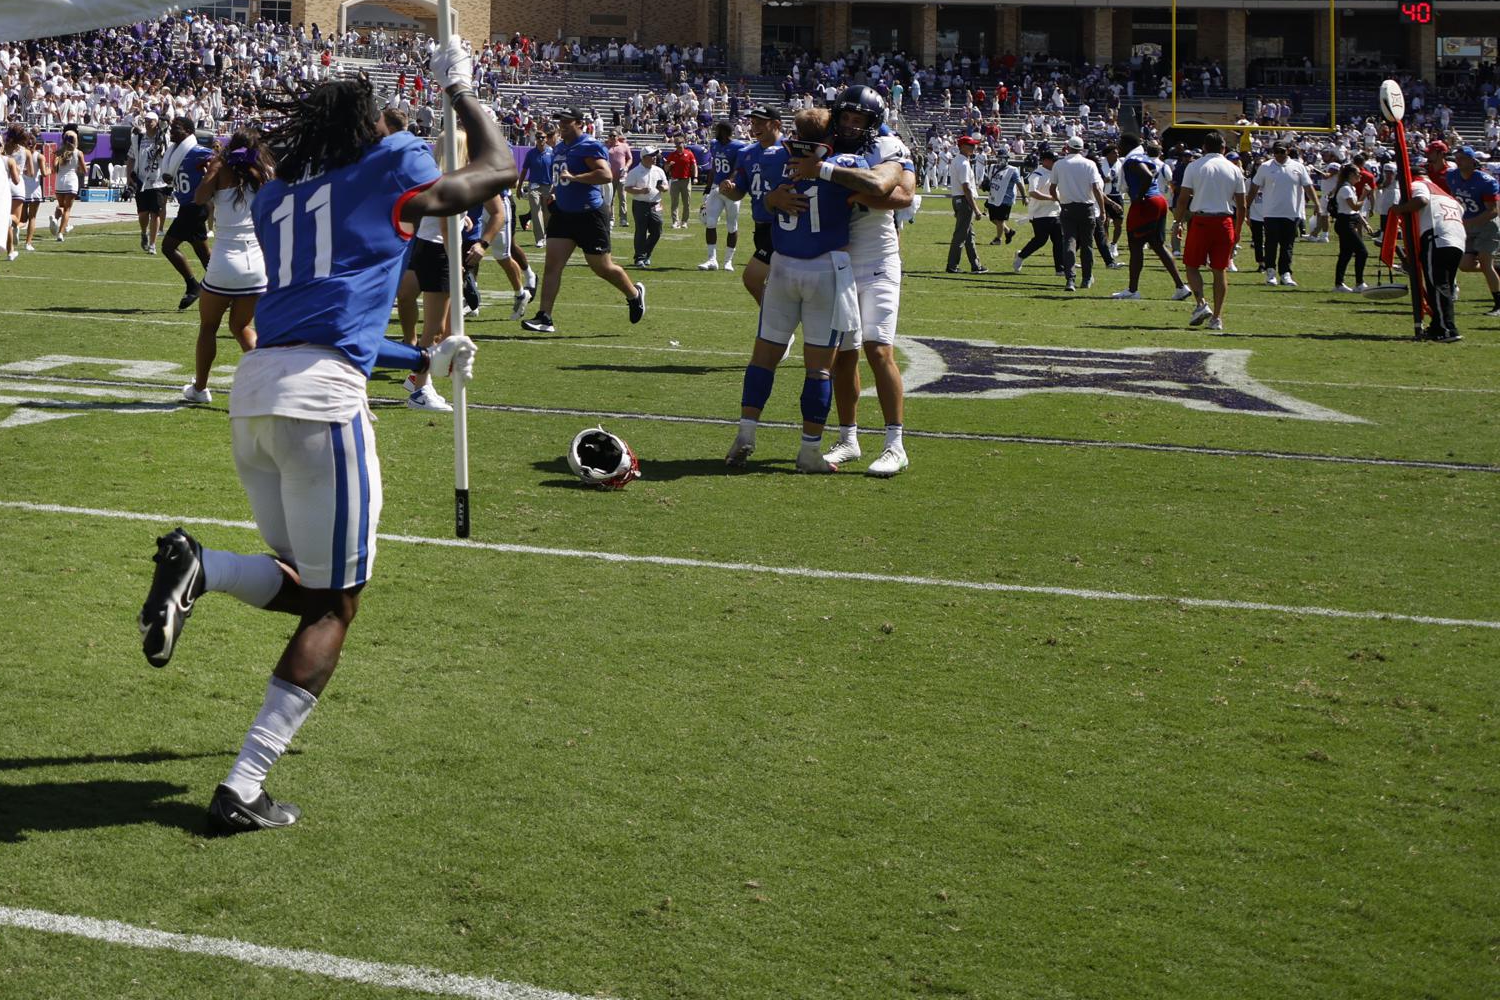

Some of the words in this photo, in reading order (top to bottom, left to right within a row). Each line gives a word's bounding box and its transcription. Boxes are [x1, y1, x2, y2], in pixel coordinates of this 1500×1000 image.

[1401, 2, 1431, 23] 40
[176, 172, 191, 194] 6
[271, 183, 332, 288] 11
